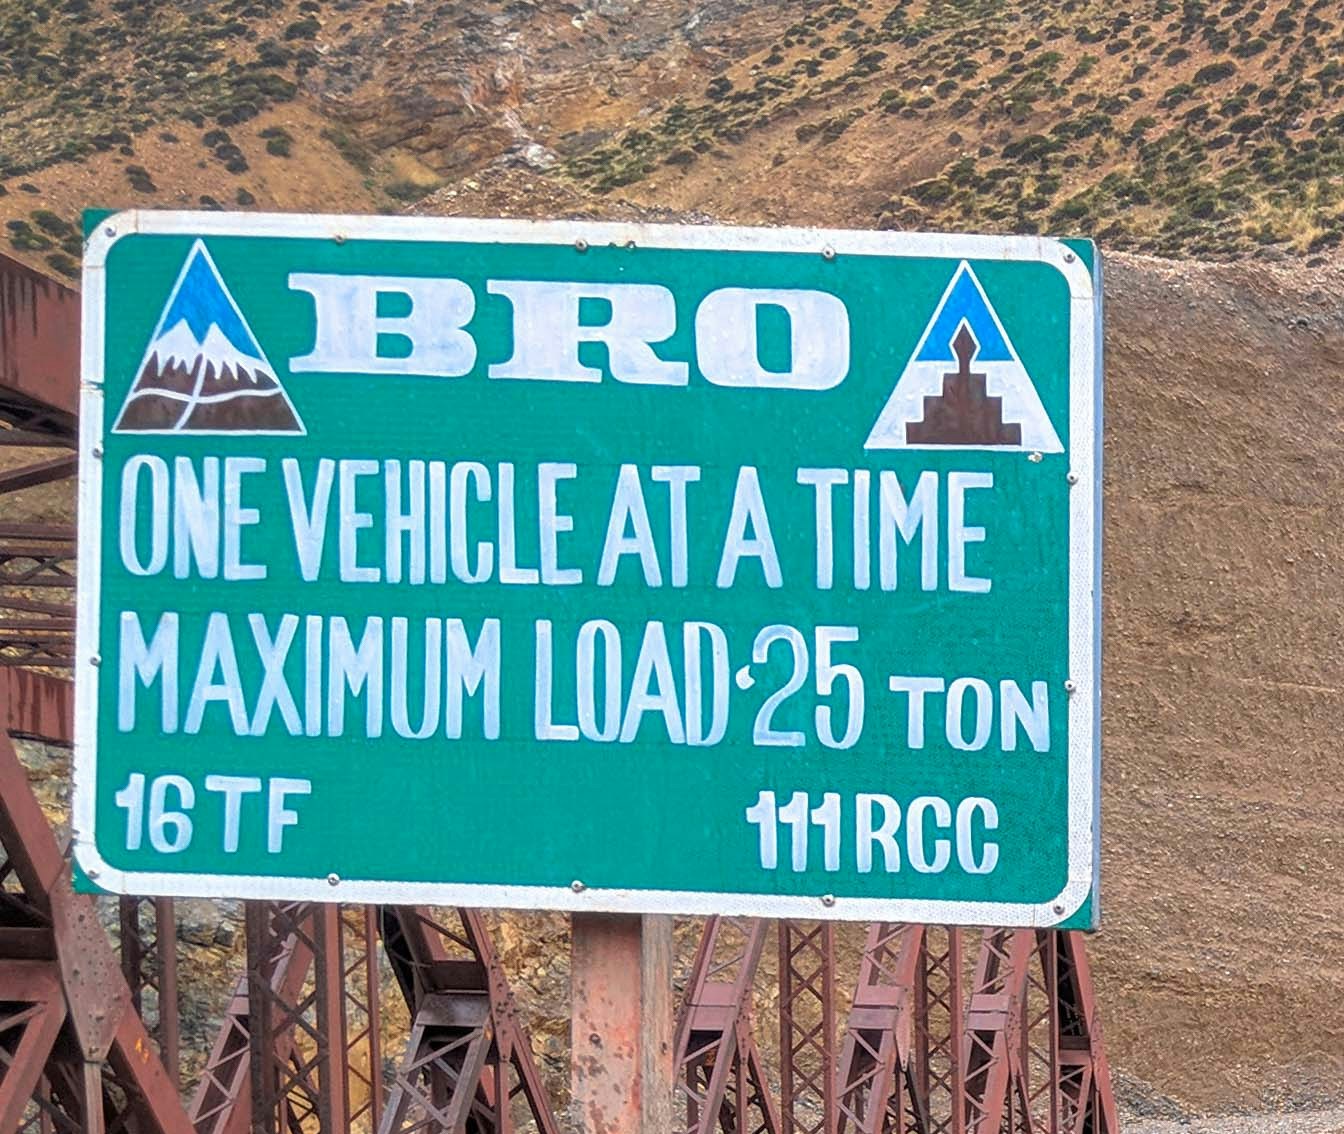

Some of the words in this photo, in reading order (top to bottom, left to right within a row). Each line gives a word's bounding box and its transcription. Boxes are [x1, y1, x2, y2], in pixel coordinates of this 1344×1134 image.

[288, 272, 851, 391] BRO
[119, 454, 267, 580] ONE
[282, 458, 583, 585] VEHICLE
[597, 463, 701, 587] AT
[717, 465, 782, 588] A
[796, 467, 994, 593] TIME
[119, 611, 501, 740] MAXIMUM
[534, 619, 730, 746] LOAD
[889, 675, 1050, 753] TON
